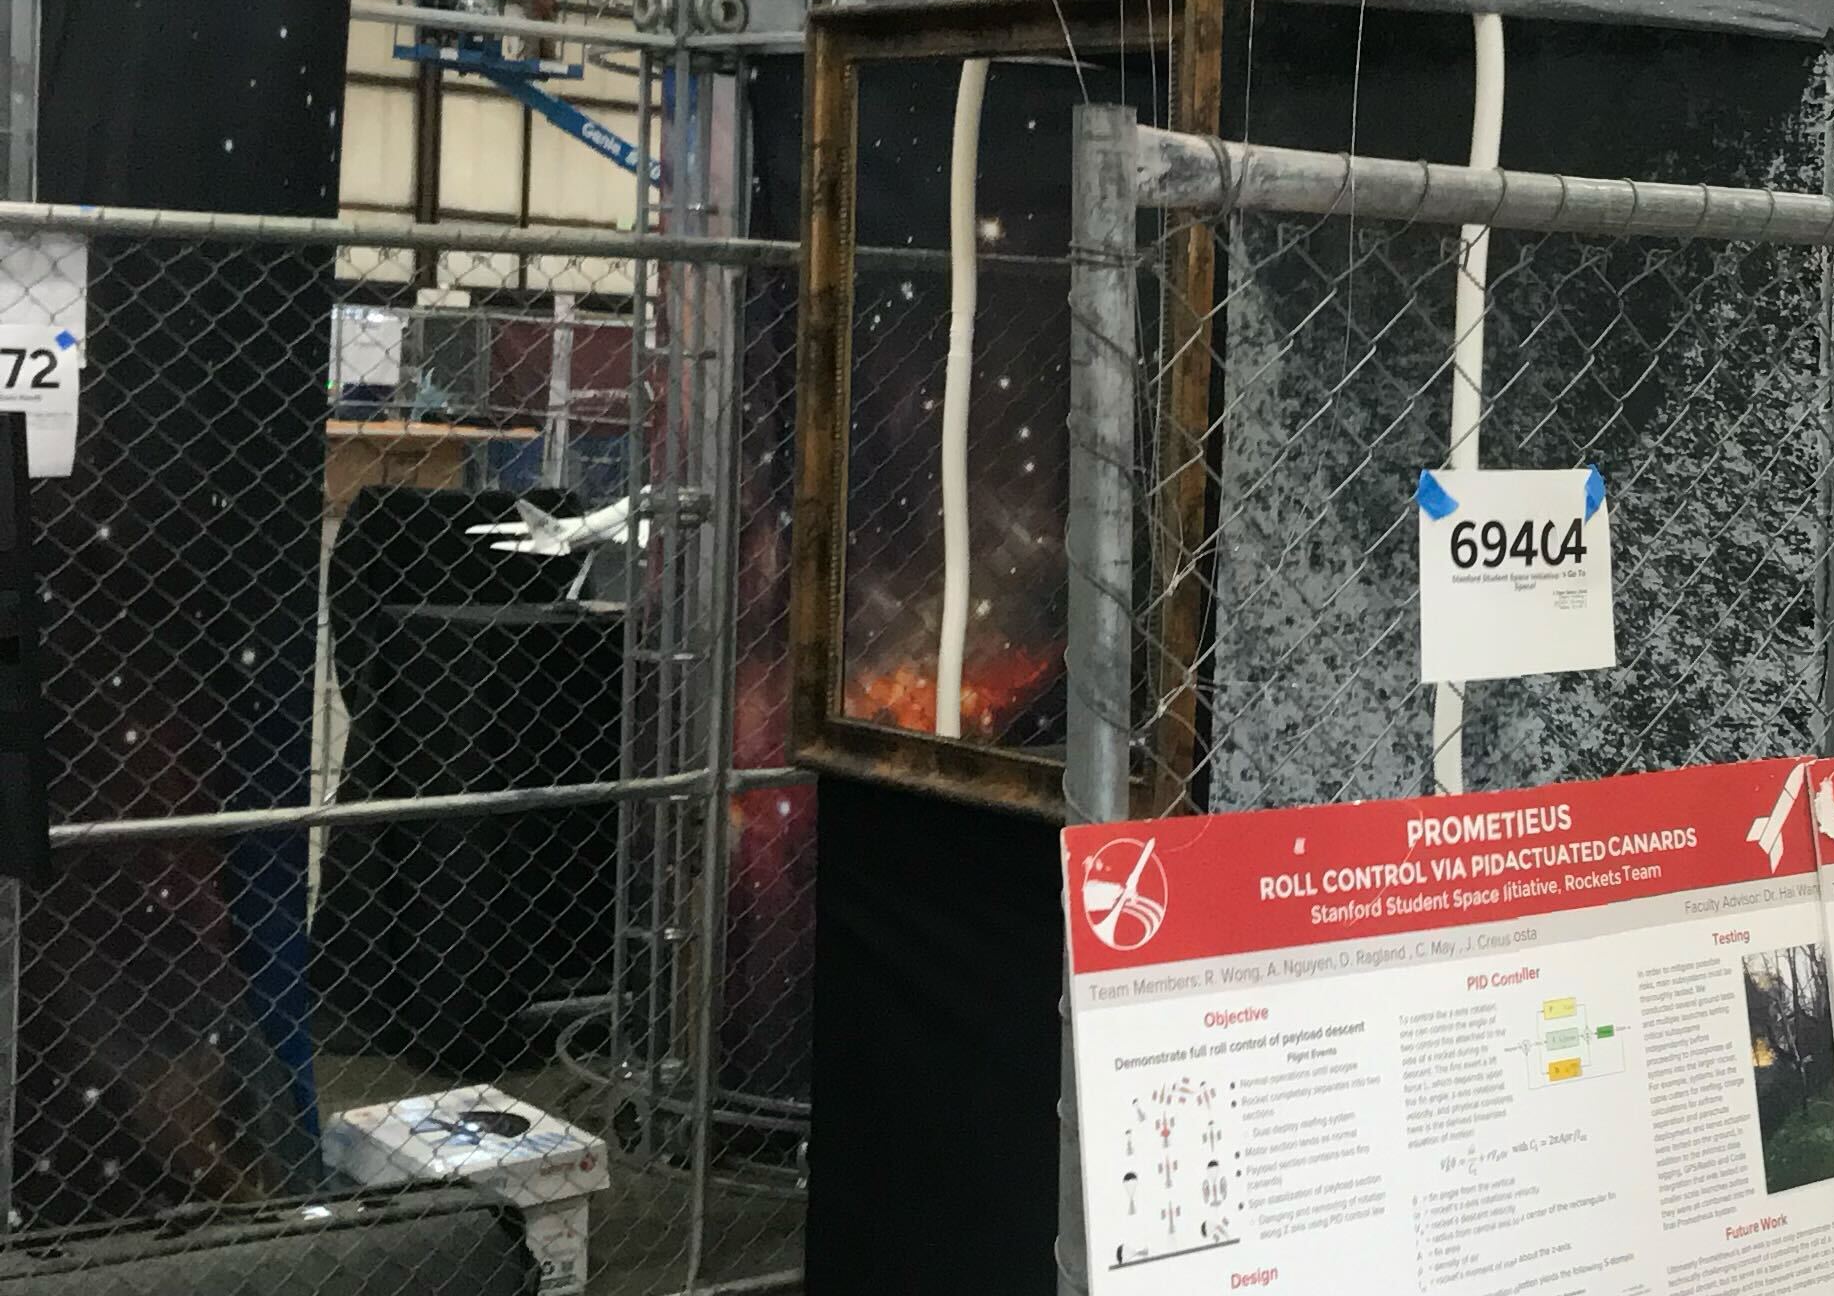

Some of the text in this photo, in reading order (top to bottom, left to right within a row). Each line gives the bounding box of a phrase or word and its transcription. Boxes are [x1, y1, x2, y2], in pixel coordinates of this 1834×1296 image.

[1259, 872, 1318, 901] ROLL
[1322, 858, 1427, 894] CONTROL
[1431, 854, 1467, 883] VIA
[1608, 826, 1698, 858] CANARDS
[1311, 894, 1383, 925] Stanford
[1386, 889, 1449, 915] Student
[1453, 885, 1500, 910] Space
[1565, 871, 1622, 893] Rockets
[1622, 862, 1663, 883] Team
[1711, 929, 1751, 948] Testing
[1090, 980, 1130, 1002] Team
[1204, 1006, 1269, 1028] Objective
[1114, 1050, 1187, 1072] Demonstrate
[1229, 1036, 1268, 1054] control
[1269, 1034, 1280, 1047] of
[1282, 1027, 1323, 1048] payload
[1325, 1022, 1365, 1038] descent
[1725, 1213, 1788, 1242] Future Work
[1230, 1266, 1279, 1290] Design
